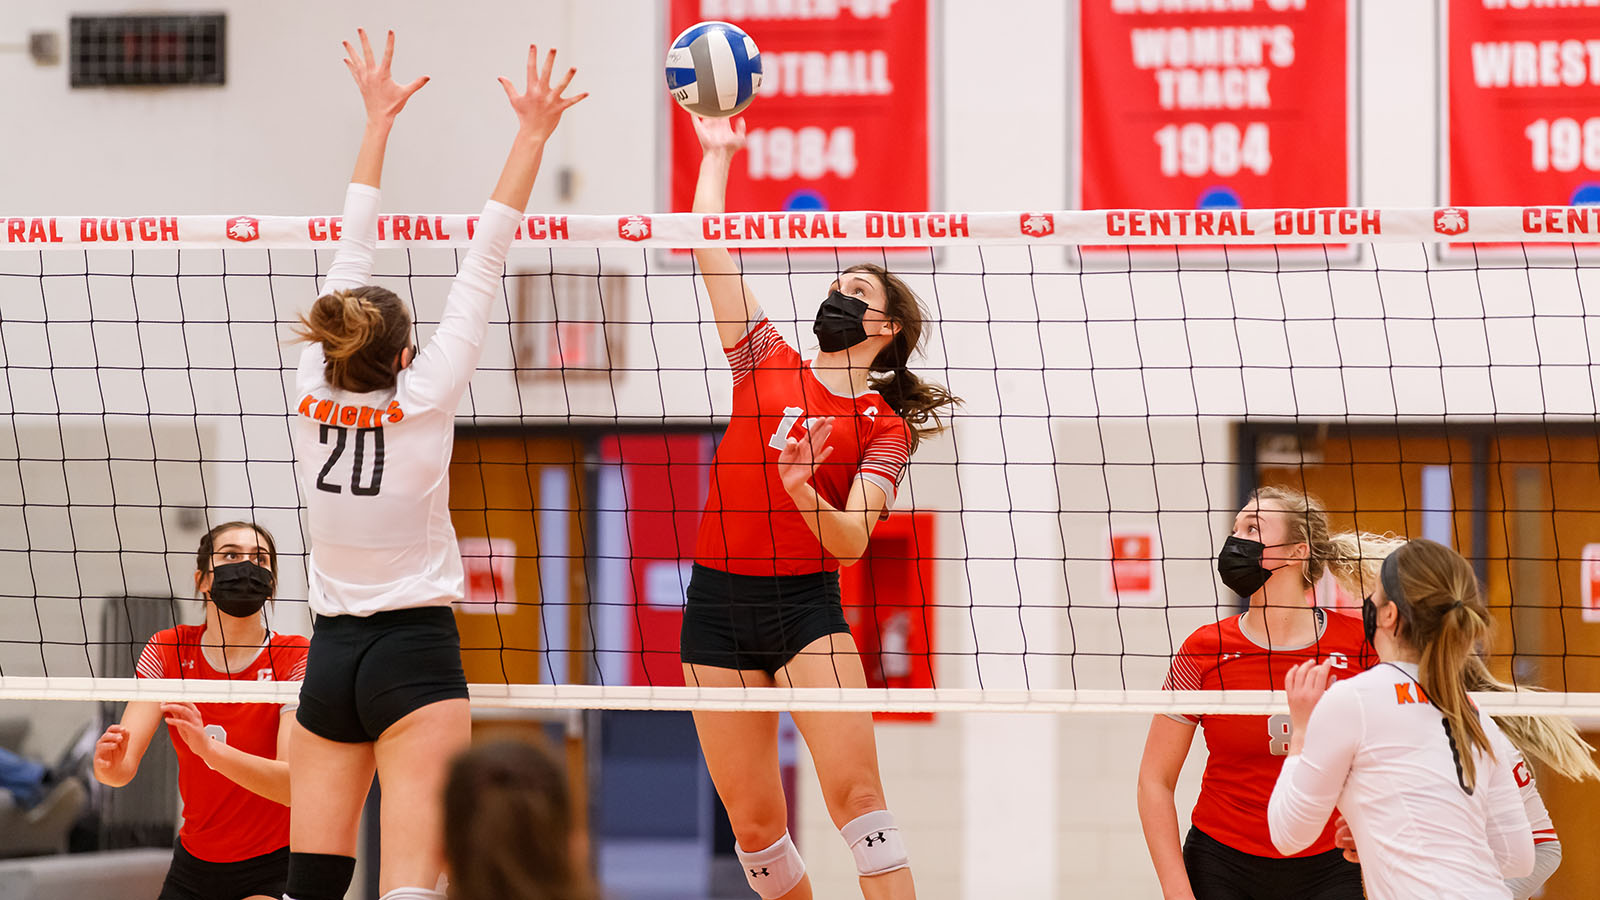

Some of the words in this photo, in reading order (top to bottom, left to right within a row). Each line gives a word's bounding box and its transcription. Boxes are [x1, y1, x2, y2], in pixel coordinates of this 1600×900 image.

[1130, 25, 1295, 69] WOMEN'S
[760, 50, 894, 97] OTBALL
[1155, 67, 1271, 110] TRACK
[746, 126, 857, 180] 1984
[1154, 122, 1272, 177] 1984
[80, 217, 179, 242] DUTCH
[308, 215, 450, 241] CETRAL
[702, 213, 847, 240] CENTRAL
[865, 212, 969, 238] DUTCH
[1106, 210, 1255, 236] CENTRAL
[1274, 208, 1382, 235] DUTCH
[298, 394, 404, 428] KNIGHTS
[316, 423, 385, 496] 20
